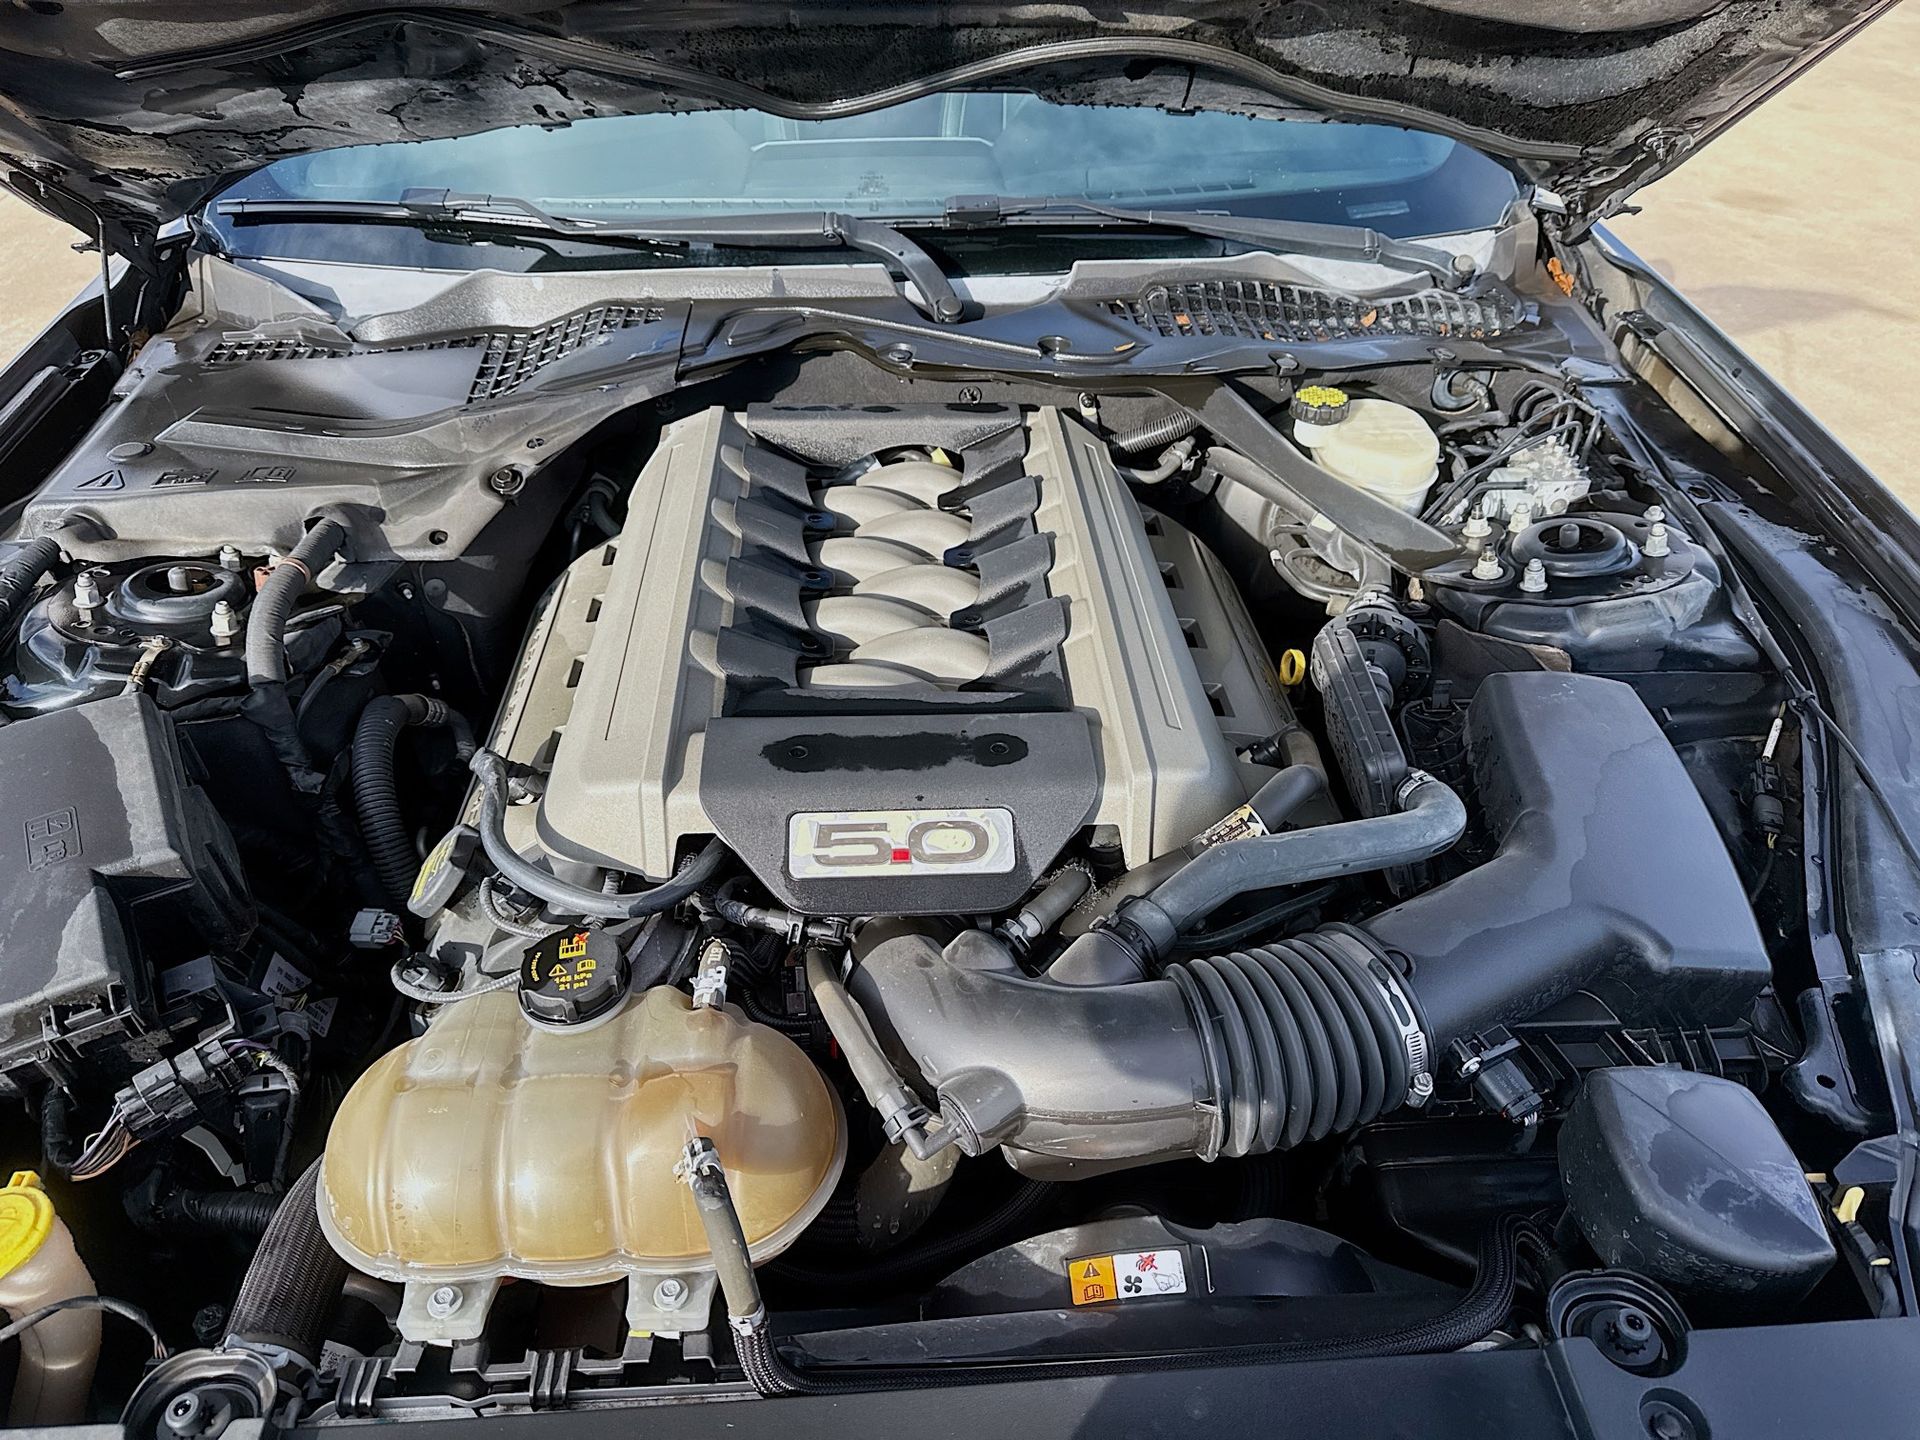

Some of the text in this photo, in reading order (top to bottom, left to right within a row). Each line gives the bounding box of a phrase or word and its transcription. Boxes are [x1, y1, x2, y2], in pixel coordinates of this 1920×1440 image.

[813, 820, 990, 867] 5.0
[574, 972, 593, 981] kPa
[559, 979, 588, 991] 21 psi
